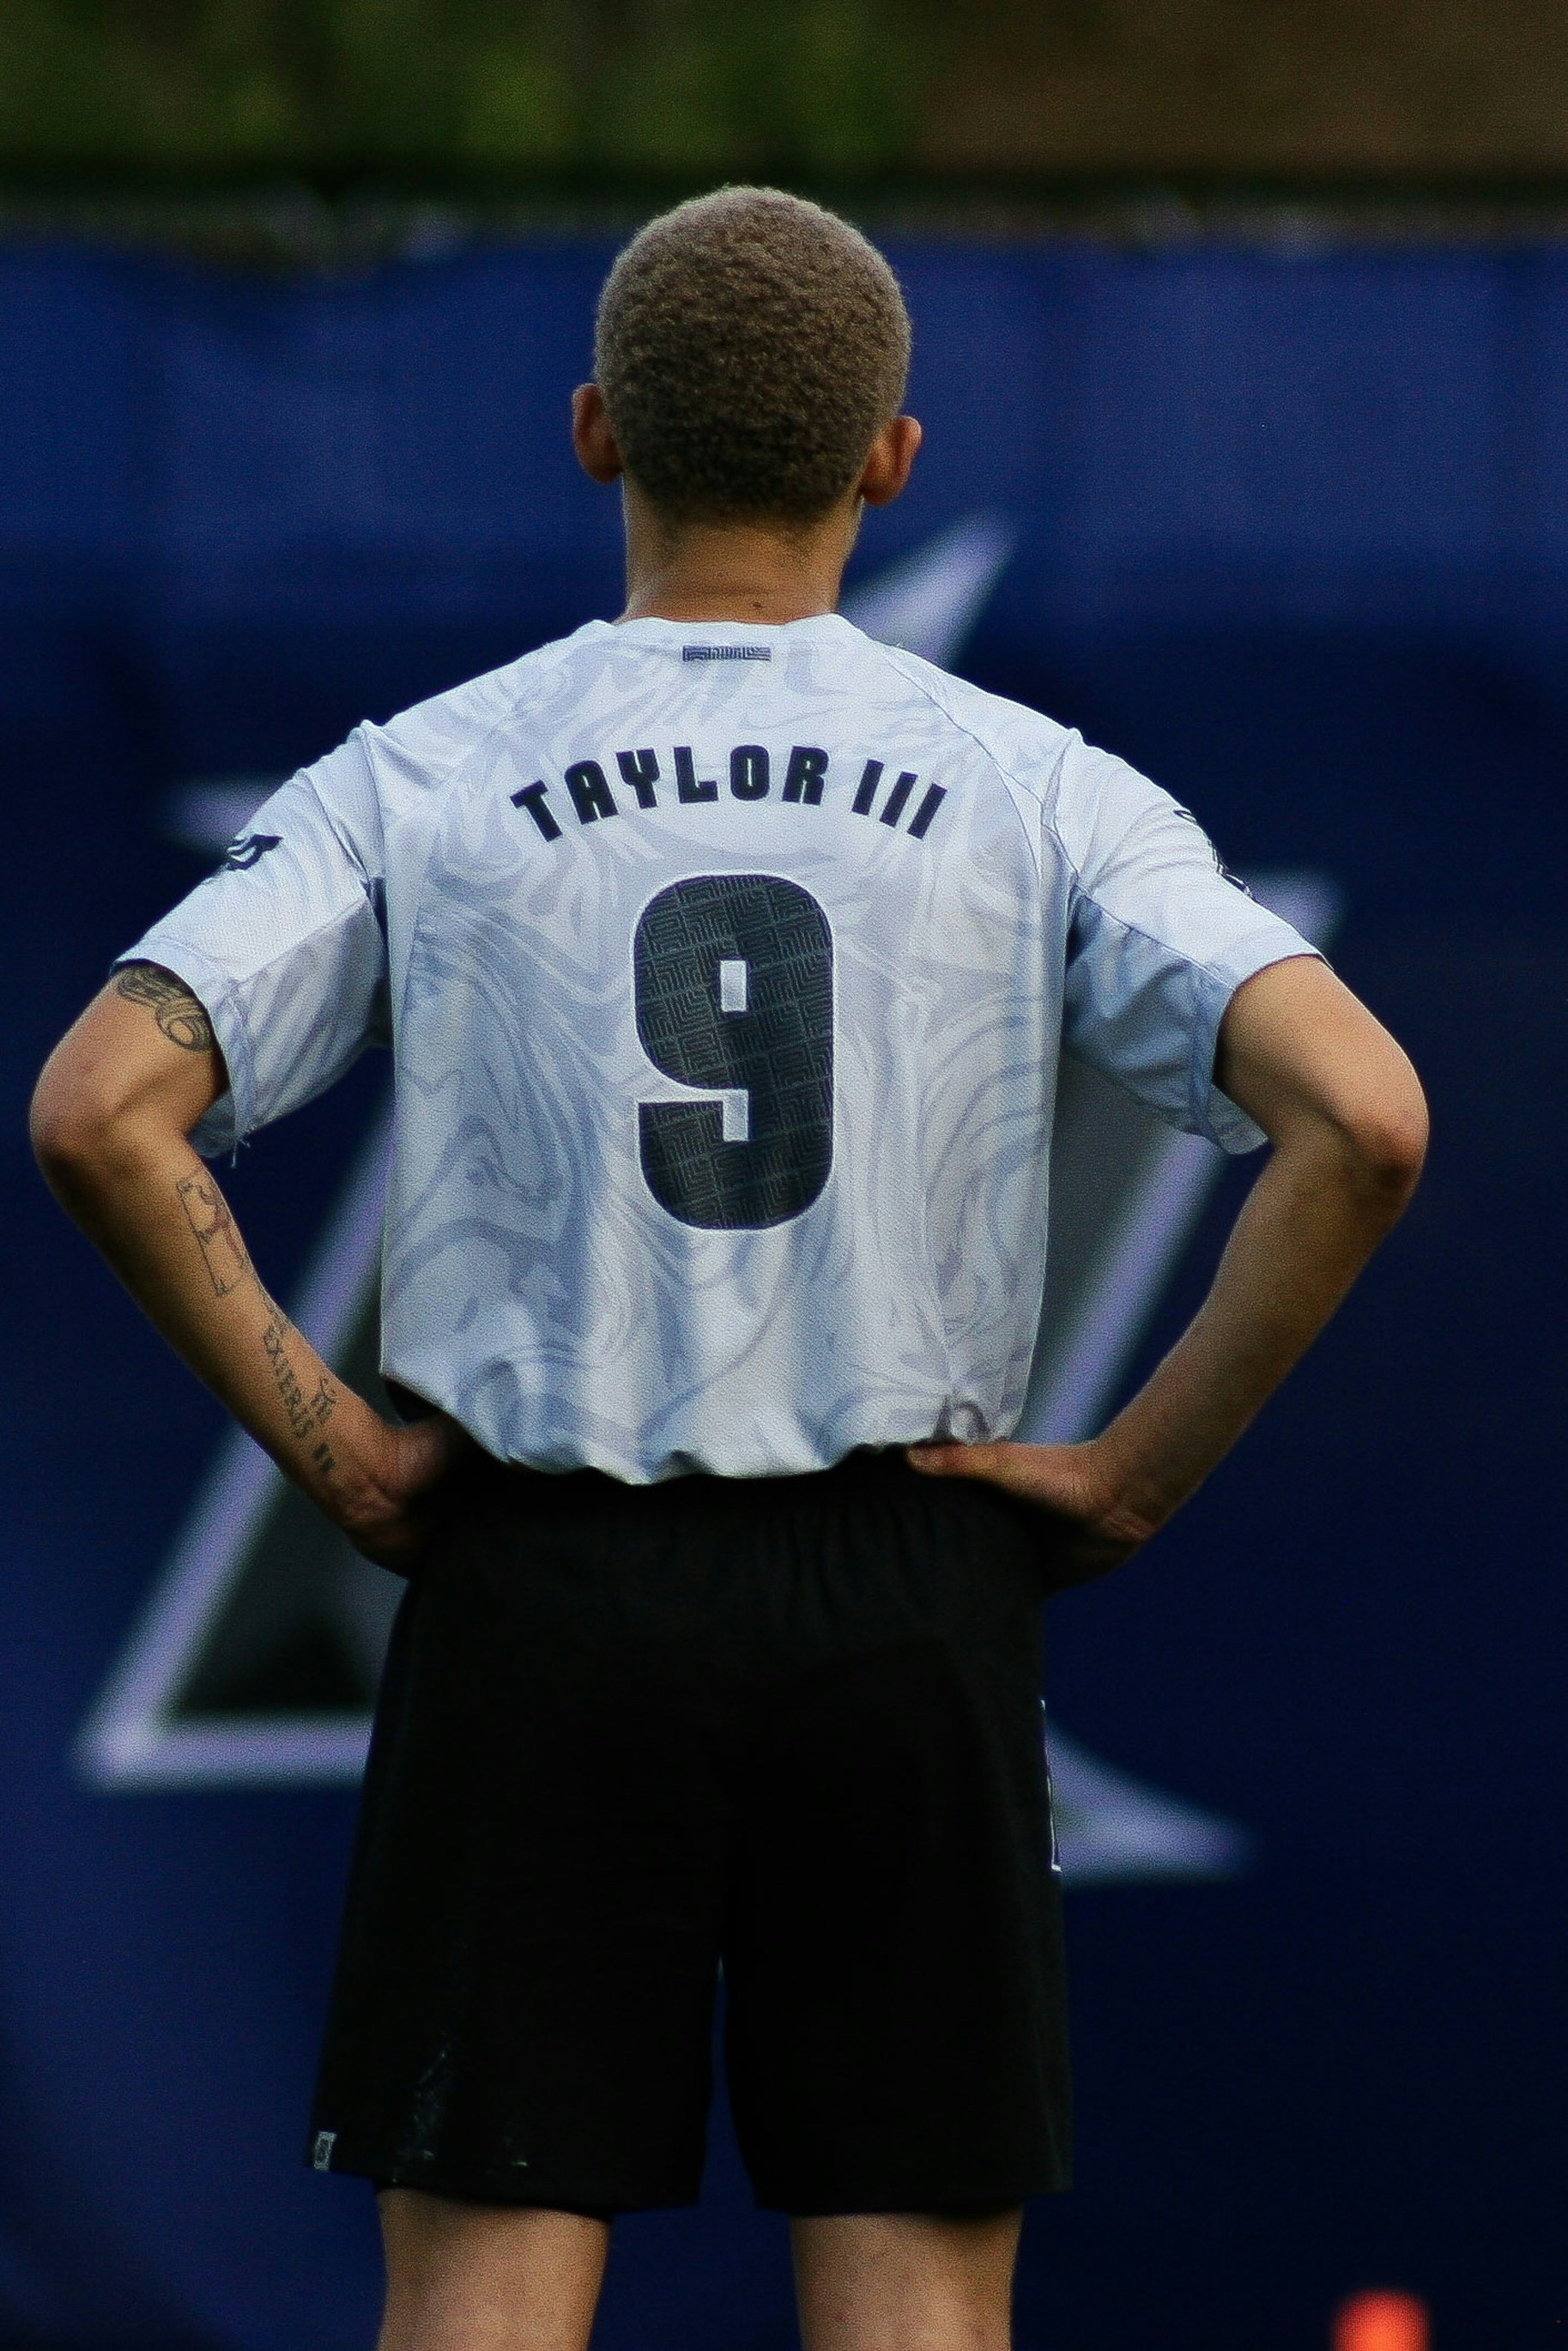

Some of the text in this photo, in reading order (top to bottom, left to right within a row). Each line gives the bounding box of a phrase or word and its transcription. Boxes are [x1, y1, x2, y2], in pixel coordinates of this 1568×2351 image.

[510, 744, 947, 842] TAYLOR III
[633, 874, 834, 1231] 9
